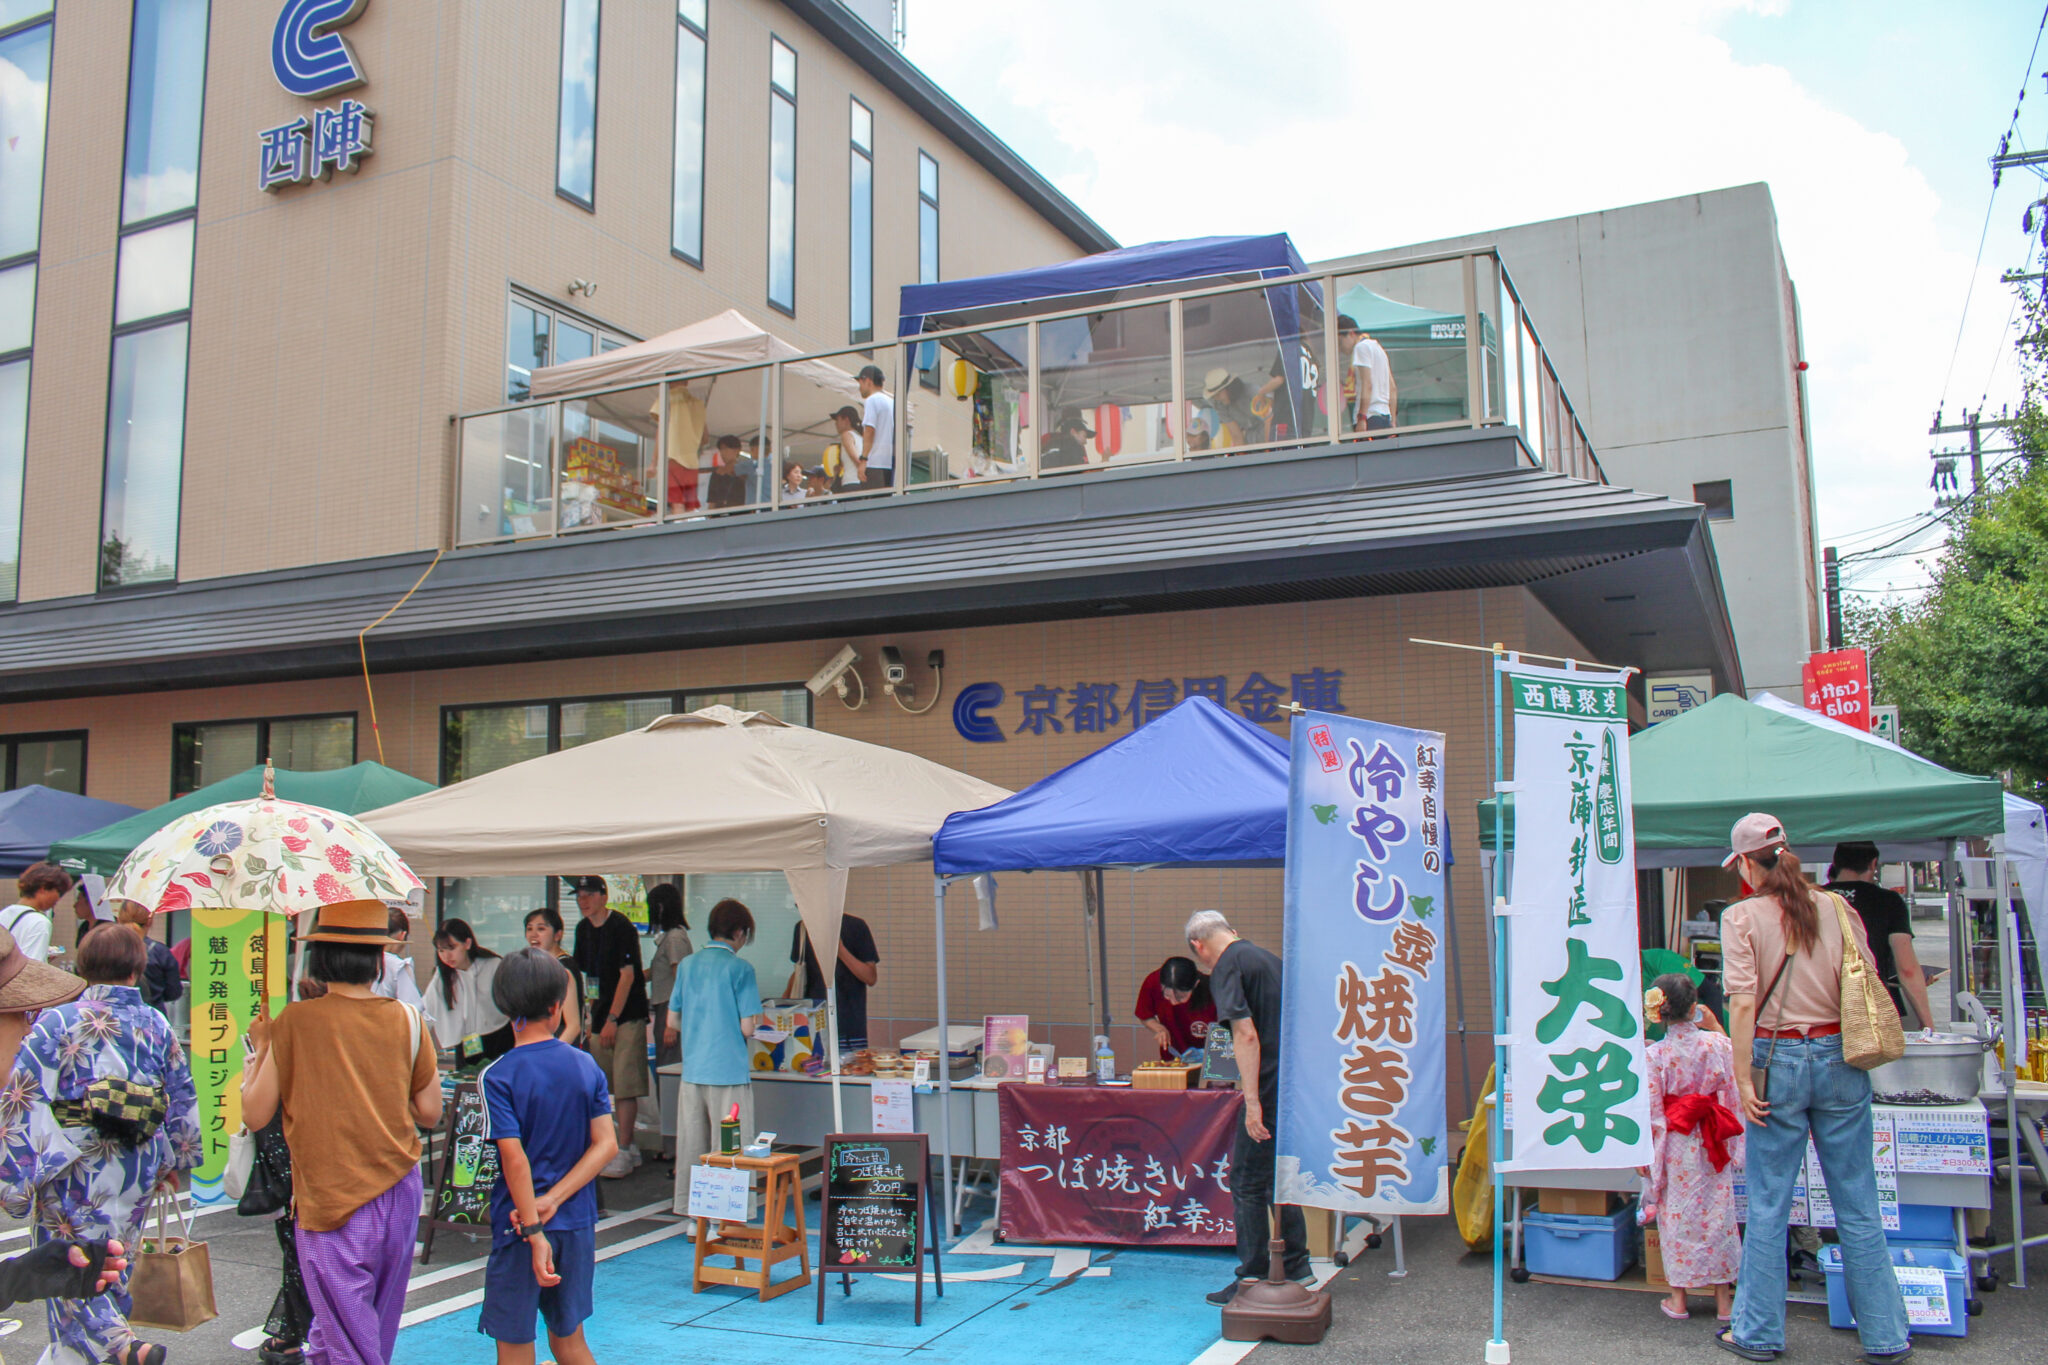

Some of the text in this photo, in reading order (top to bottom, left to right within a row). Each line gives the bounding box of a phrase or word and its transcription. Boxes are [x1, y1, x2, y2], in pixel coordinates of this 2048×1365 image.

[258, 99, 371, 191] 西陣
[1013, 666, 1348, 736] 京都信用金庫
[1652, 708, 1678, 718] CARD
[1312, 730, 1339, 768] 特製
[1347, 737, 1409, 923] 冷やし
[1416, 743, 1441, 875] 紅幸自慢の
[208, 935, 229, 1155] 魅力発信プロジェクト
[1535, 937, 1642, 1154] 大栄
[1329, 962, 1419, 1201] 焼き芋
[851, 1164, 905, 1178] つぼ焼きいも
[1017, 1123, 1071, 1155] 京都
[869, 1180, 901, 1193] 300円
[1017, 1153, 1232, 1197] つぼ焼きいも
